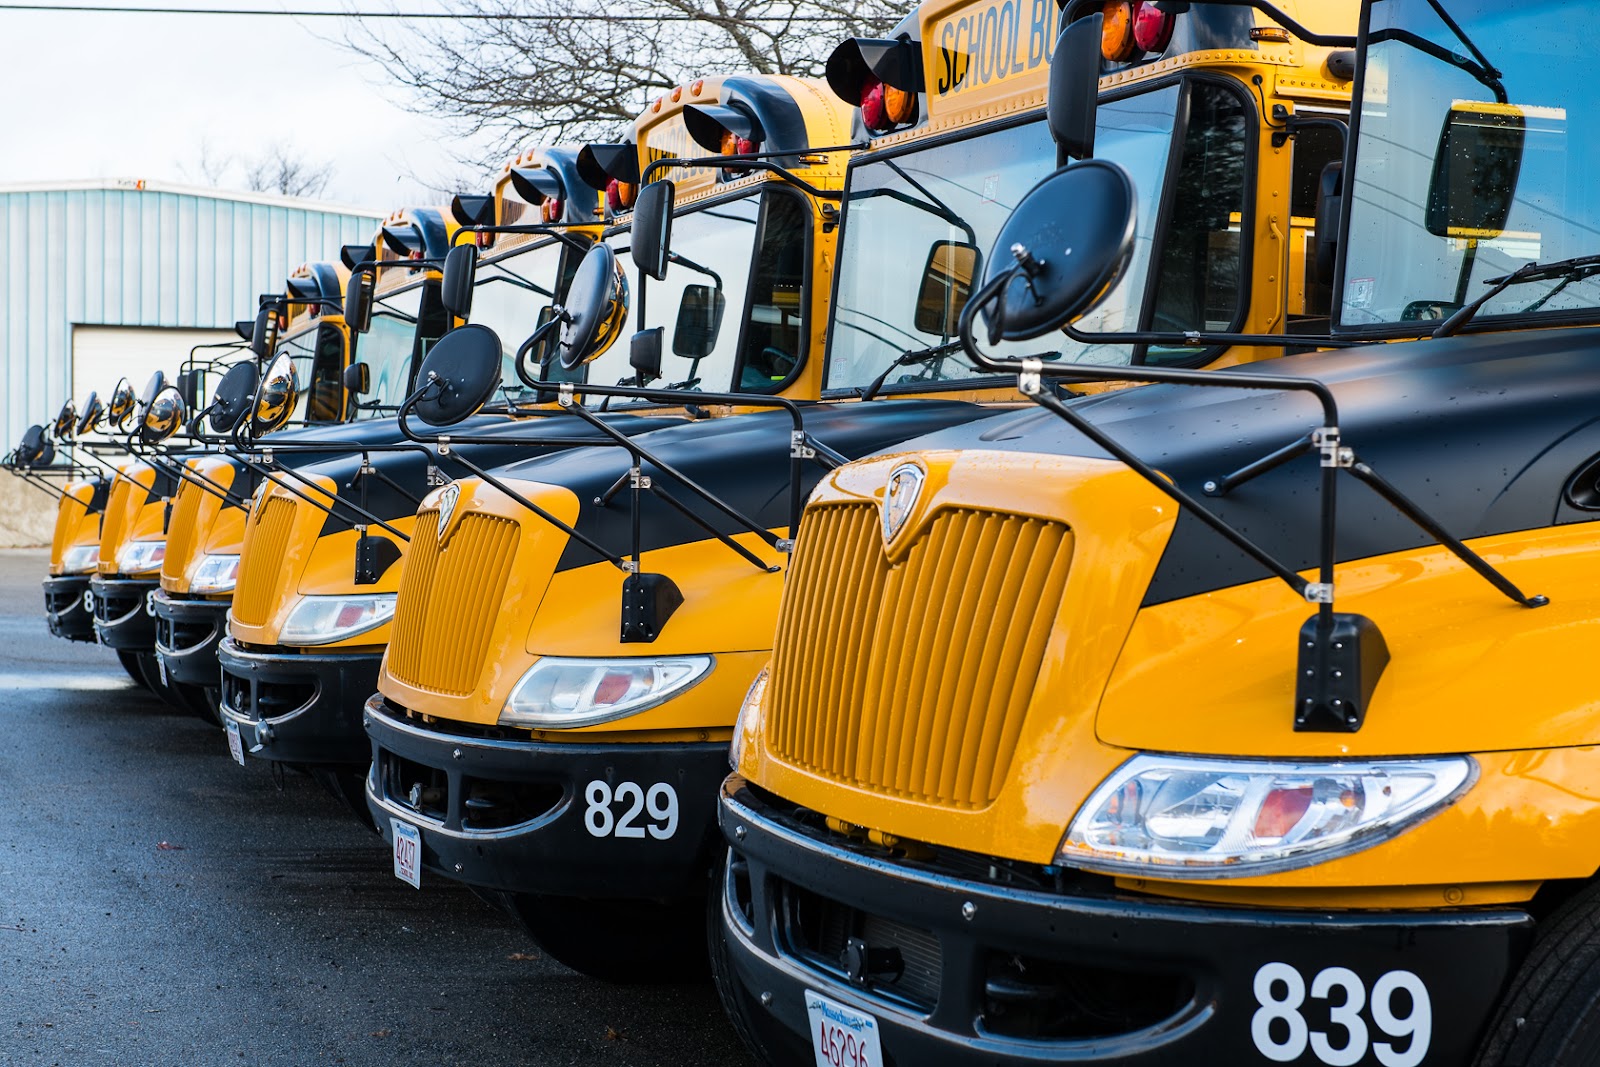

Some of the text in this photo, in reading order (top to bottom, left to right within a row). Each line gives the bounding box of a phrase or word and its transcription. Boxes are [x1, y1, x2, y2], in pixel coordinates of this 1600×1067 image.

[938, 0, 1060, 97] SCHOOL BU
[584, 779, 679, 840] 829
[820, 1019, 869, 1067] 46296
[1251, 961, 1433, 1067] 839
